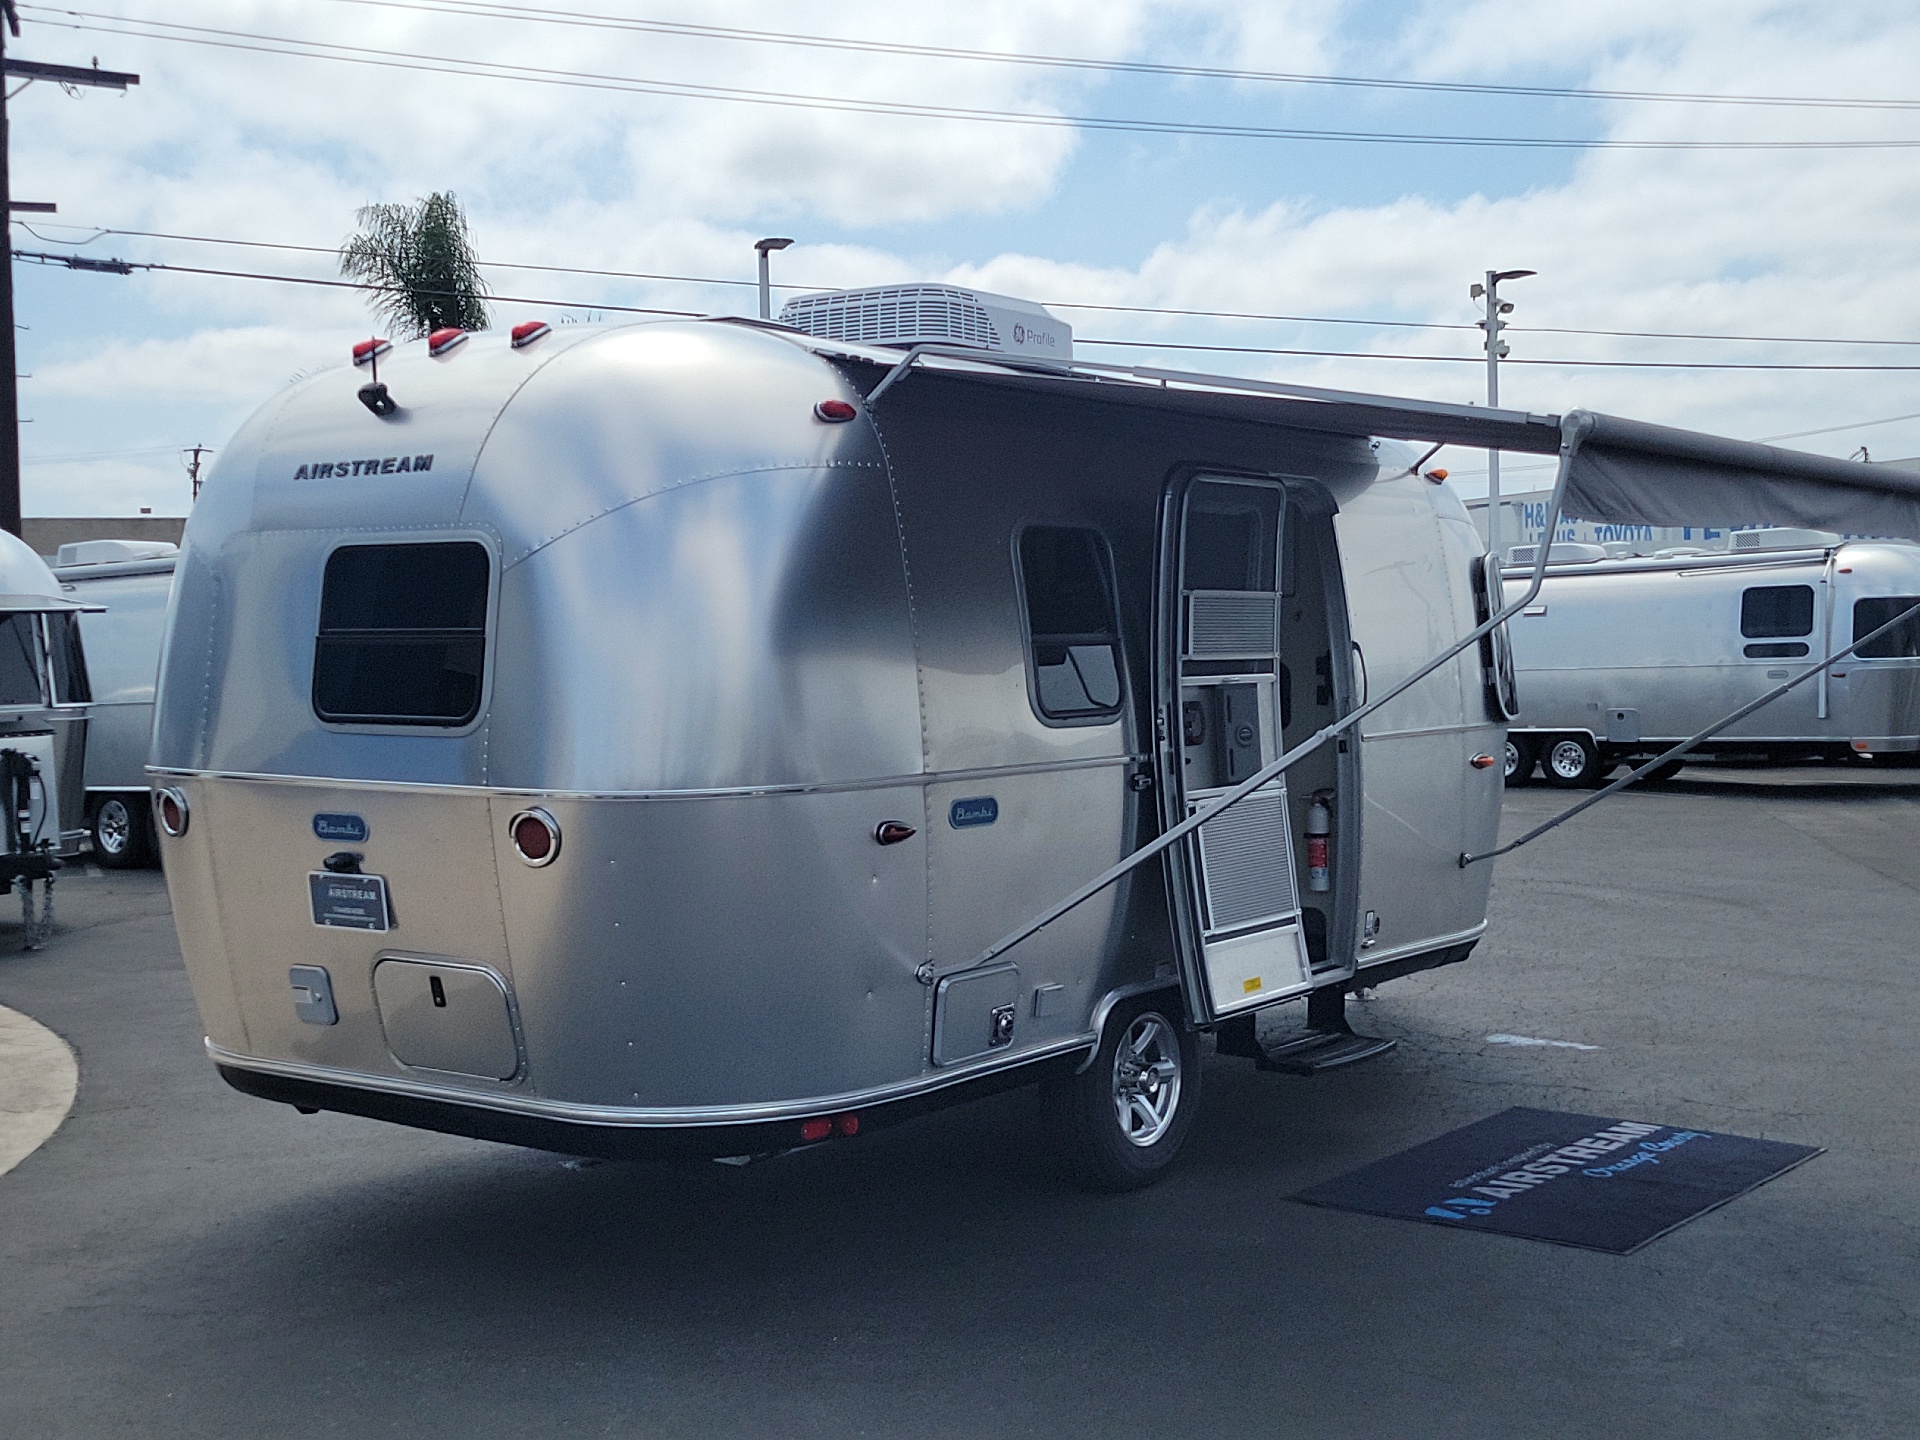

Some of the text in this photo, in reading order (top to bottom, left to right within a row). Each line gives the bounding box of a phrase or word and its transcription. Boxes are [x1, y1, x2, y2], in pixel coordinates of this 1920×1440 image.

[1027, 329, 1055, 347] Profile
[294, 453, 434, 480] AIRSTREAM
[328, 888, 377, 900] AIRSTREAM
[1472, 1120, 1663, 1199] AIRSTREAM
